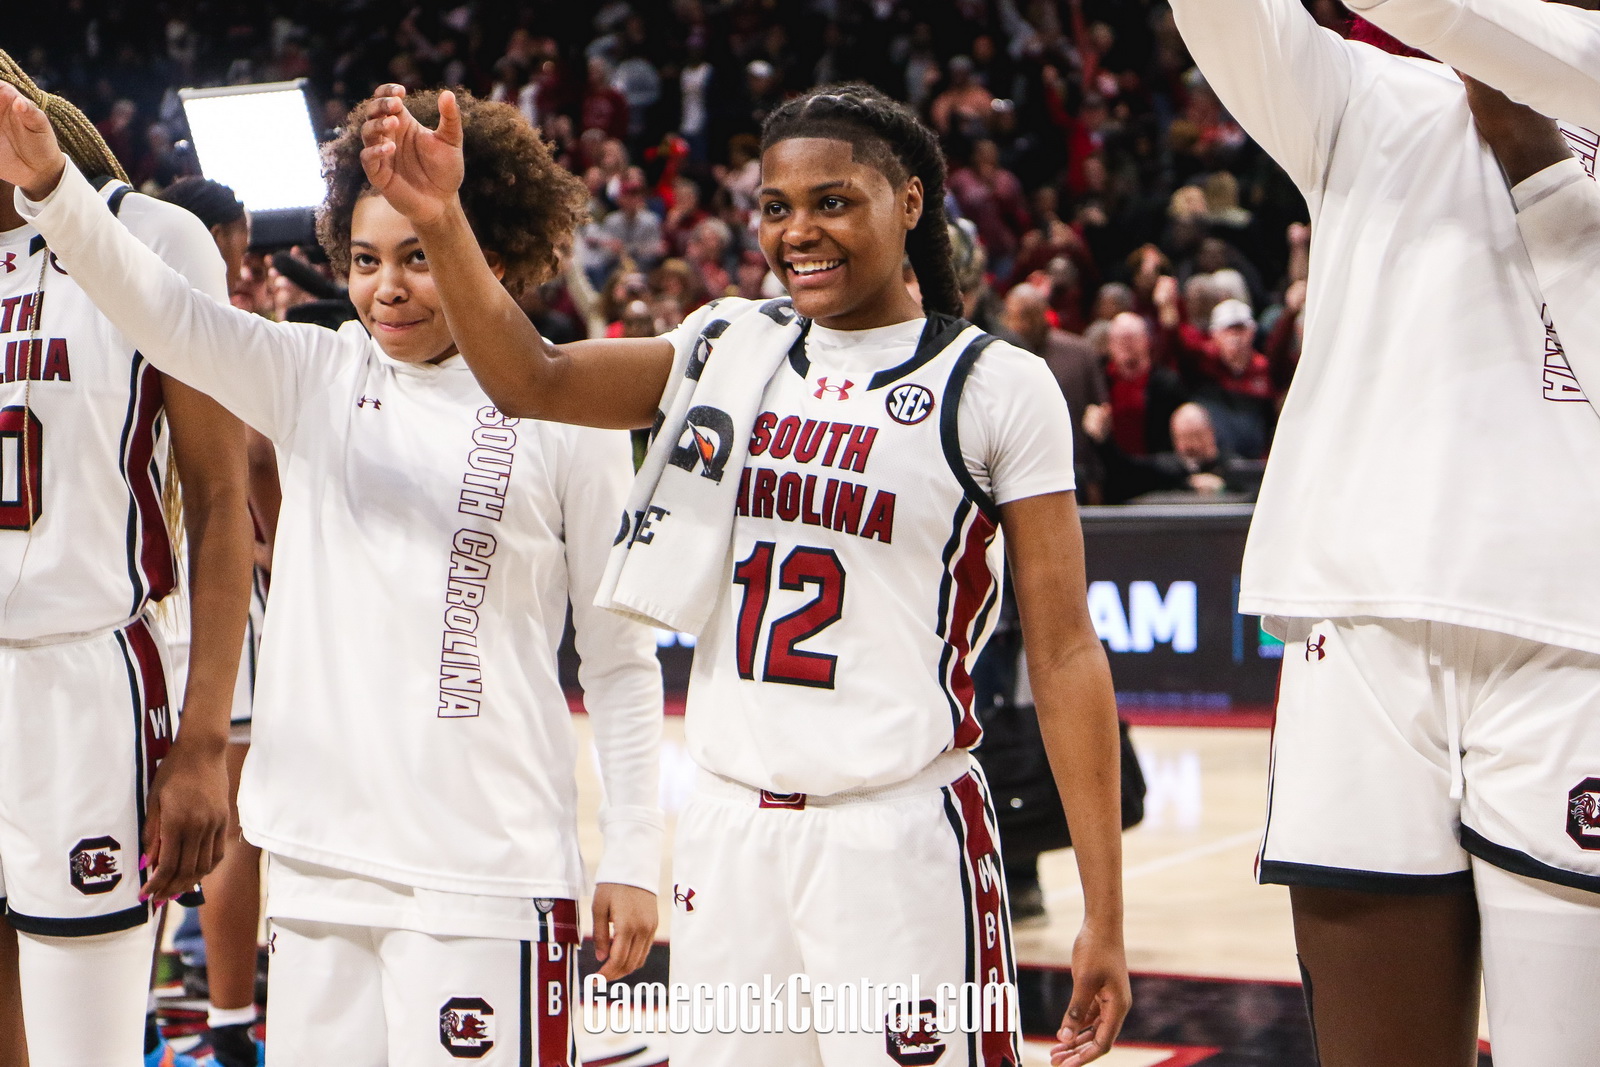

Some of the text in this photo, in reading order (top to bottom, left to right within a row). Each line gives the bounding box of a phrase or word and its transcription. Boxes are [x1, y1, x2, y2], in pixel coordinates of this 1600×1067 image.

[748, 411, 879, 473] SOUTH
[887, 384, 932, 423] SEC
[735, 466, 897, 544] AROLINA
[437, 405, 521, 718] SOUTH CAROLINA
[733, 541, 846, 690] 12
